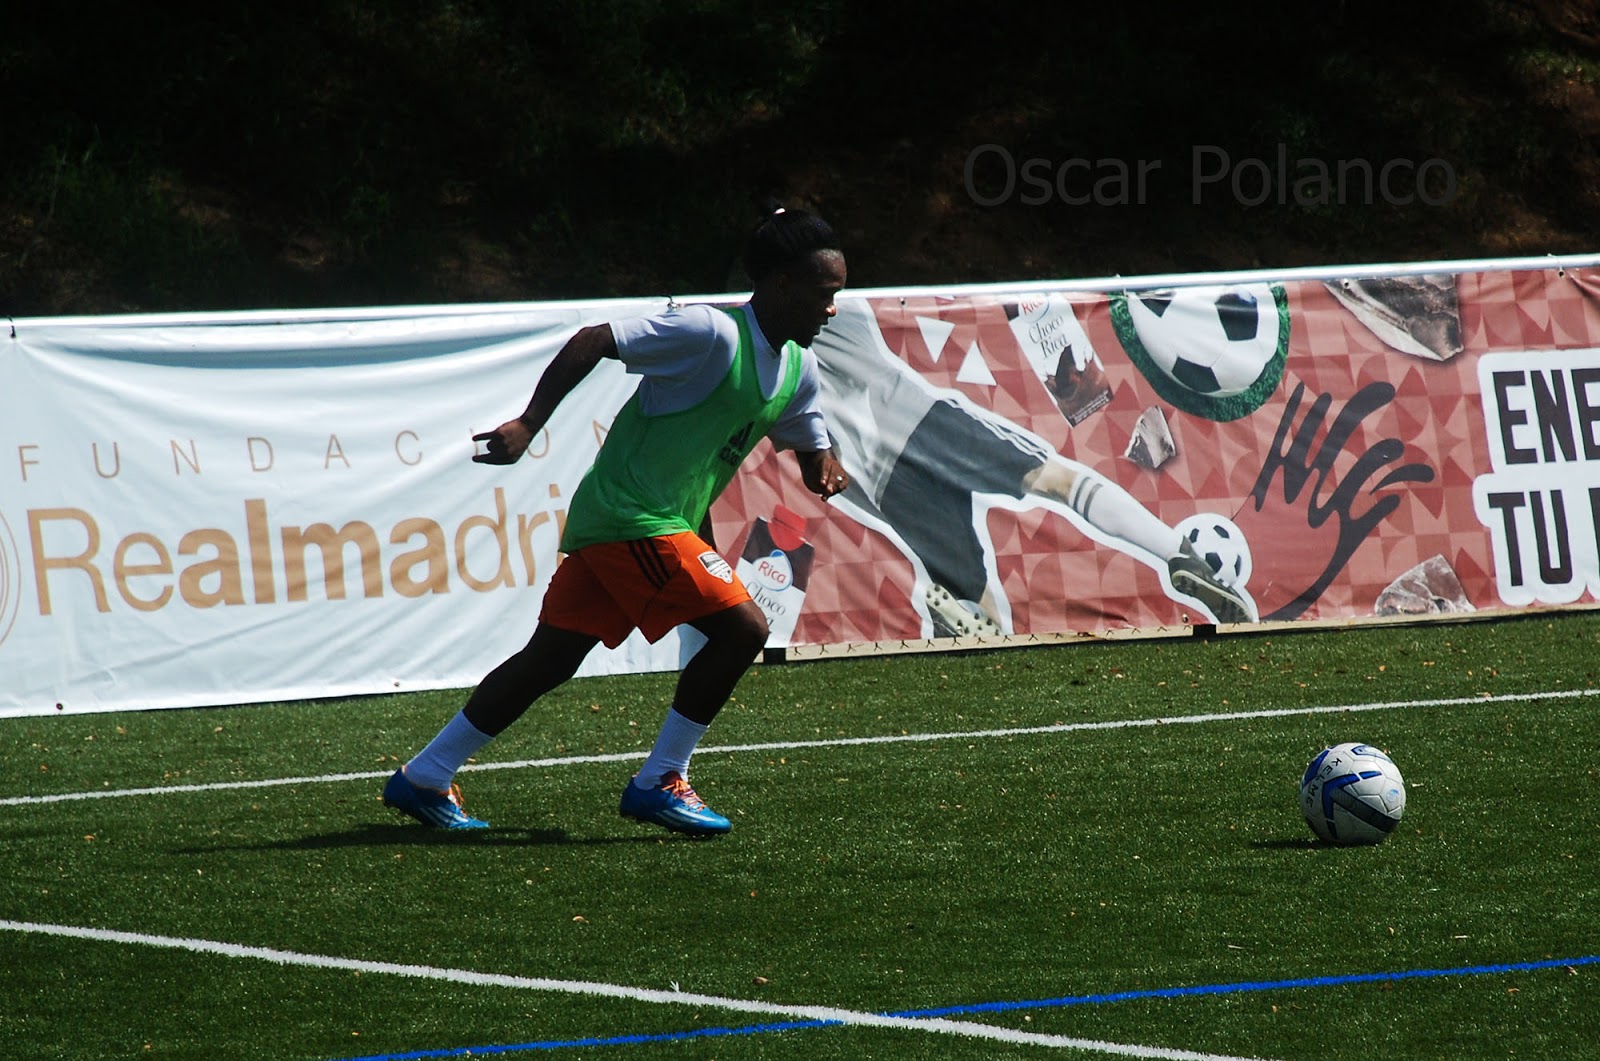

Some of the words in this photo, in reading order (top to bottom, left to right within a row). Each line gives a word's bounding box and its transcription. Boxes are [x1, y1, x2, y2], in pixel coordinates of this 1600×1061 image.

[1028, 315, 1065, 345] Choco
[1040, 333, 1069, 359] Rica
[1492, 367, 1600, 465] ENE
[1487, 489, 1573, 587] TU
[758, 560, 787, 584] Rica
[746, 580, 787, 617] Choco
[1305, 757, 1342, 808] KELME
